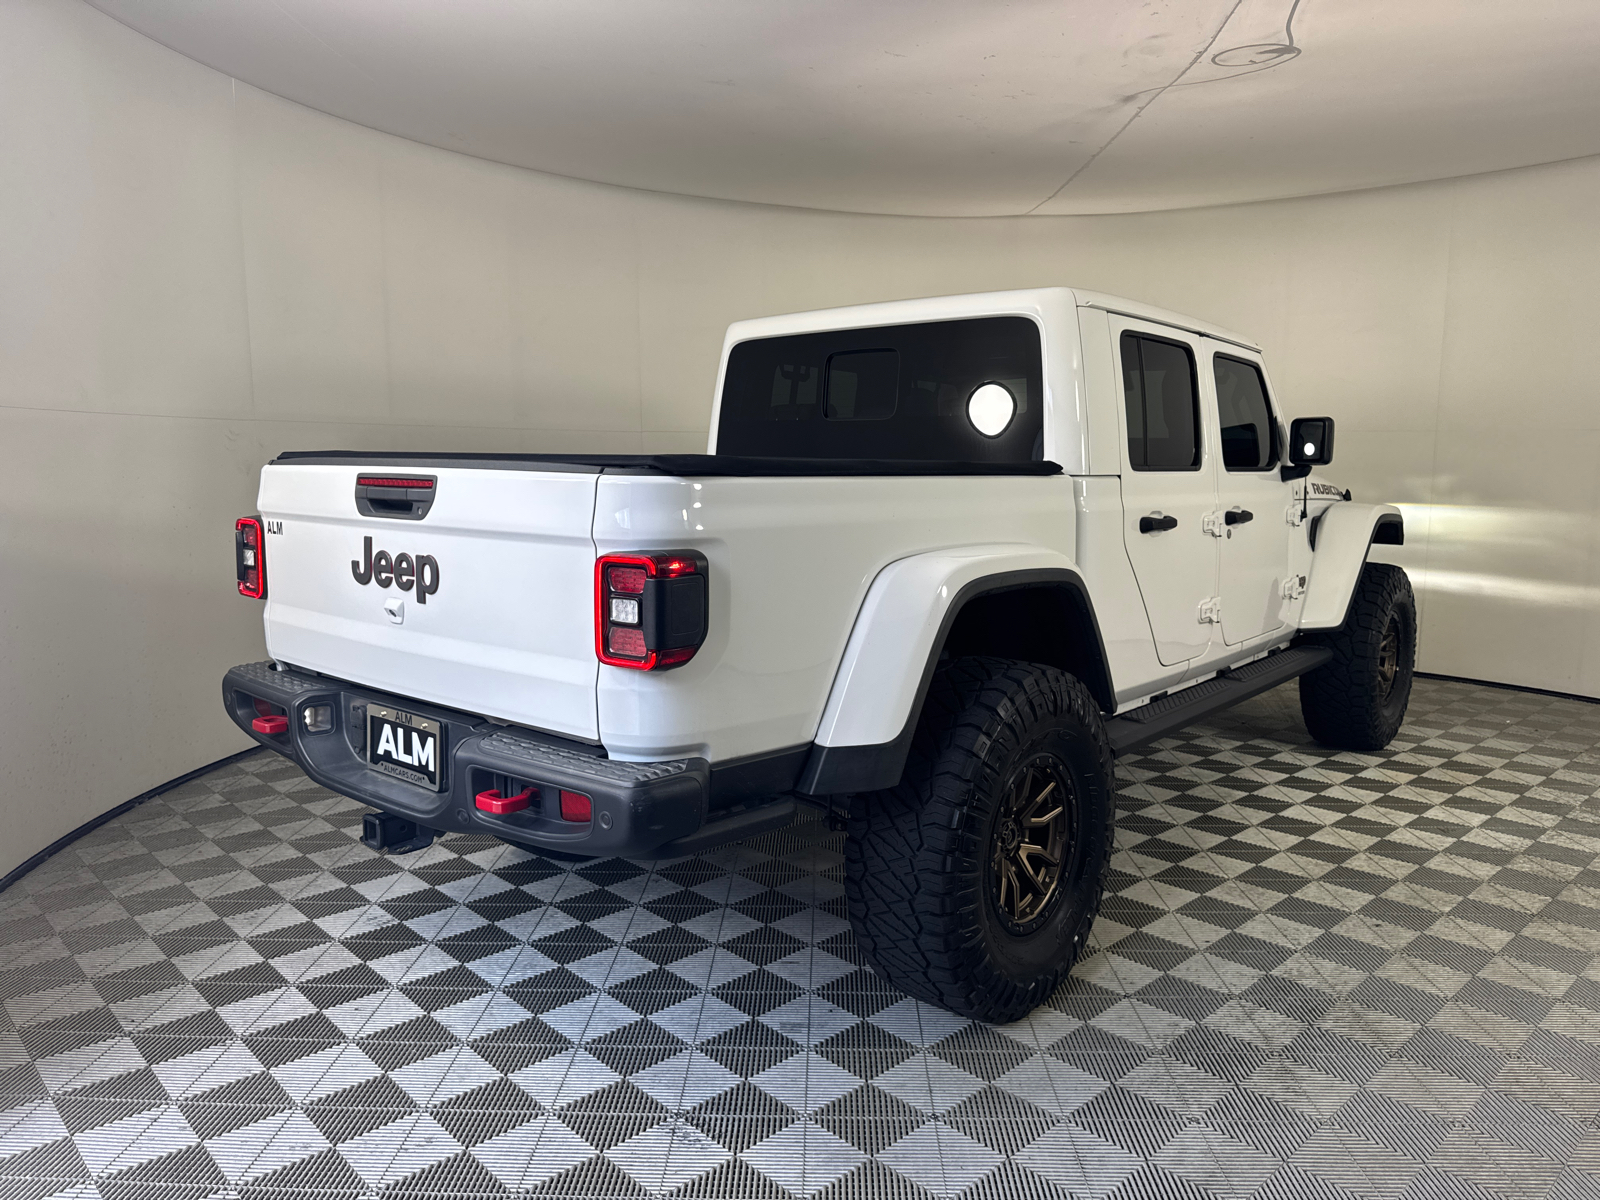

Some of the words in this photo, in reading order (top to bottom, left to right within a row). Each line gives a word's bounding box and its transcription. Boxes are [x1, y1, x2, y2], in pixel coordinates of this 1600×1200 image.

[1311, 482, 1341, 496] RUBICO
[267, 520, 283, 535] ALM
[351, 535, 440, 605] Jeep
[394, 711, 413, 726] ALM
[377, 723, 435, 772] ALM
[383, 765, 423, 784] ALMCARS.COM
